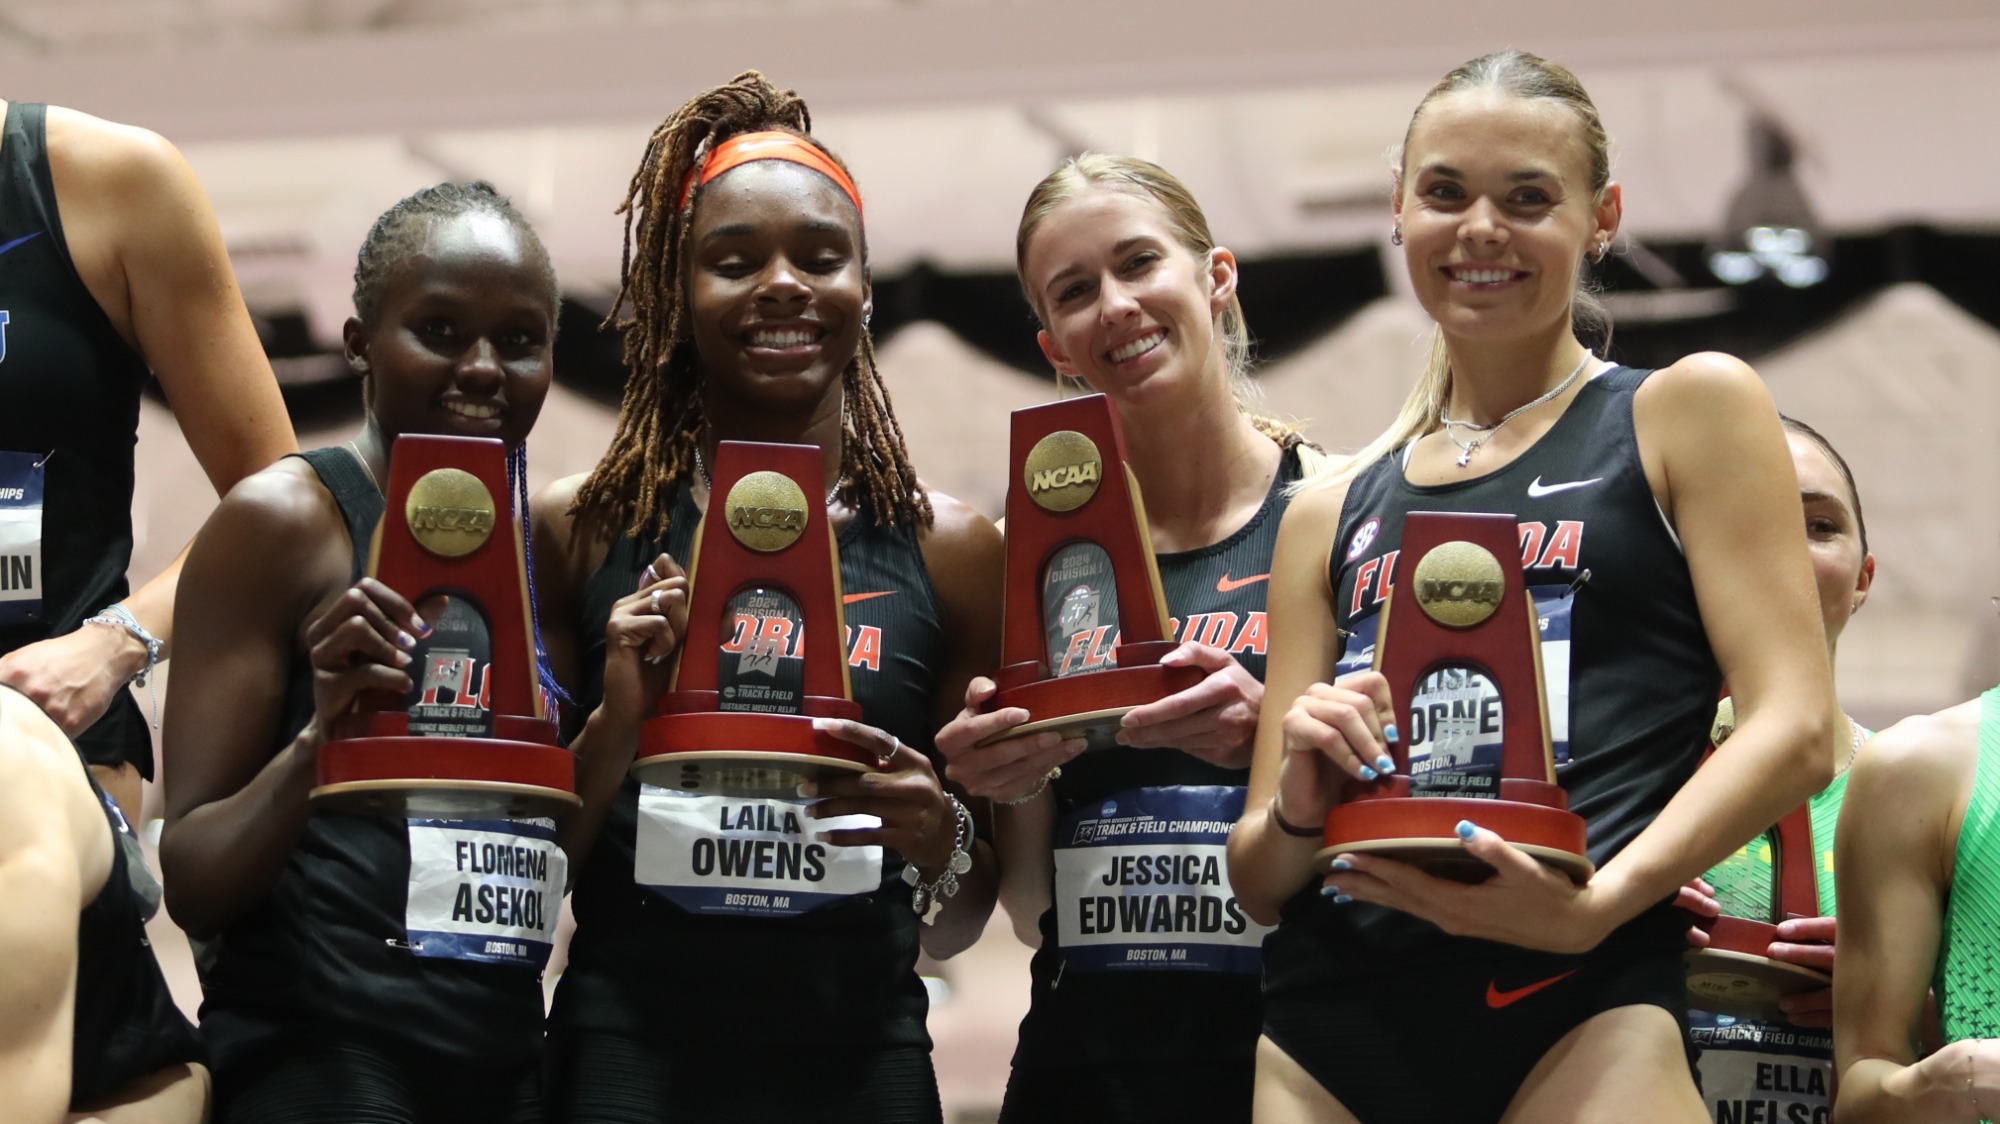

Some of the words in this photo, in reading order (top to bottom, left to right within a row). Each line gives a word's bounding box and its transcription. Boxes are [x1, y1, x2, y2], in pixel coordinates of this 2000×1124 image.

[1032, 462, 1098, 492] NCAA
[413, 506, 491, 532] NCAA
[732, 506, 804, 531] NCAA
[1061, 553, 1090, 569] 2024
[1051, 563, 1097, 583] DIVISION
[1421, 577, 1499, 606] NCAA
[748, 597, 779, 608] 2024
[737, 689, 763, 698] TRACK
[771, 690, 794, 700] FIELD
[423, 707, 450, 717] TRACK
[458, 708, 482, 718] FIELD
[720, 702, 751, 711] DISTANCE
[751, 704, 777, 713] MEDLEY
[777, 705, 797, 714] RELAY
[1411, 755, 1452, 774] BOSTON,
[1431, 775, 1458, 785] TRACK
[1467, 776, 1492, 786] FIELD
[720, 804, 802, 834] LAILA
[1096, 823, 1129, 836] TRACK
[1128, 822, 1138, 834] &
[1137, 820, 1167, 834] FIELD
[455, 840, 548, 882] FLOMENA
[692, 837, 827, 883] OWENS
[1102, 854, 1221, 886] JESSICA
[451, 882, 545, 931] ASEKOL
[725, 893, 770, 908] BOSTON,
[772, 896, 790, 909] MA
[1079, 894, 1248, 936] EDWARDS
[484, 941, 517, 956] BOSTON,
[1126, 949, 1168, 961] BOSTON,
[1170, 949, 1187, 960] MA
[1715, 1028, 1751, 1041] TRACK
[1763, 1032, 1795, 1045] FIELD
[1756, 1062, 1827, 1097] ELLA
